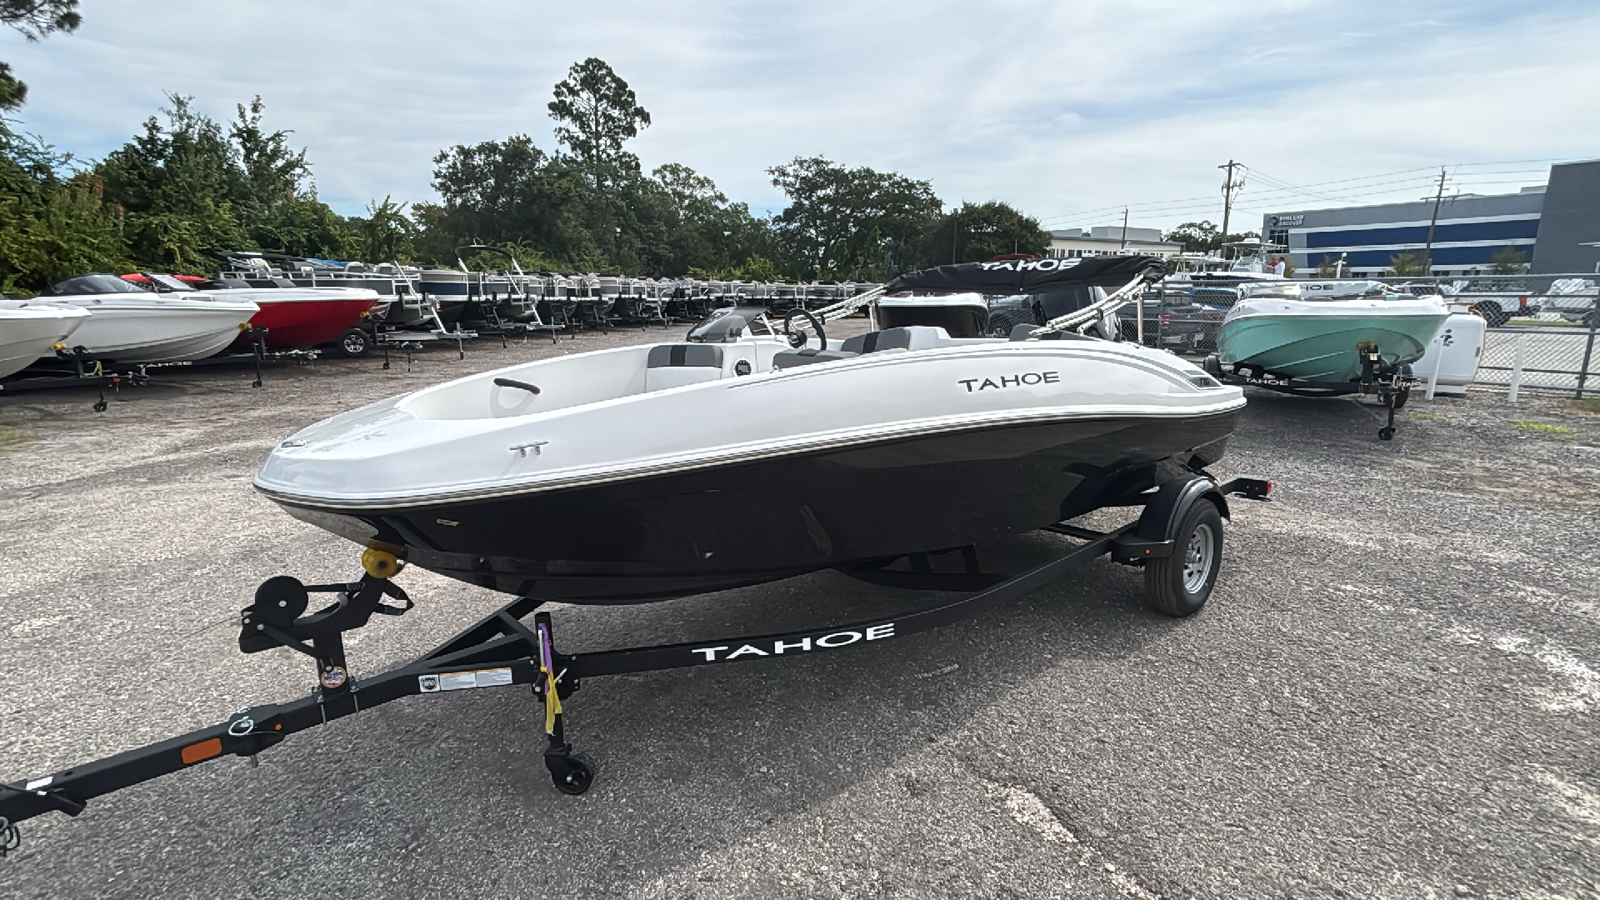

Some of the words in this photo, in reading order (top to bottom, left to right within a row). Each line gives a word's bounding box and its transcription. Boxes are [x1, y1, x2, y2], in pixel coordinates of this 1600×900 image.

[981, 258, 1082, 272] TAHOE
[957, 371, 1061, 392] TAHOE
[1245, 377, 1289, 386] TAHOE
[691, 622, 895, 662] TAHOE
